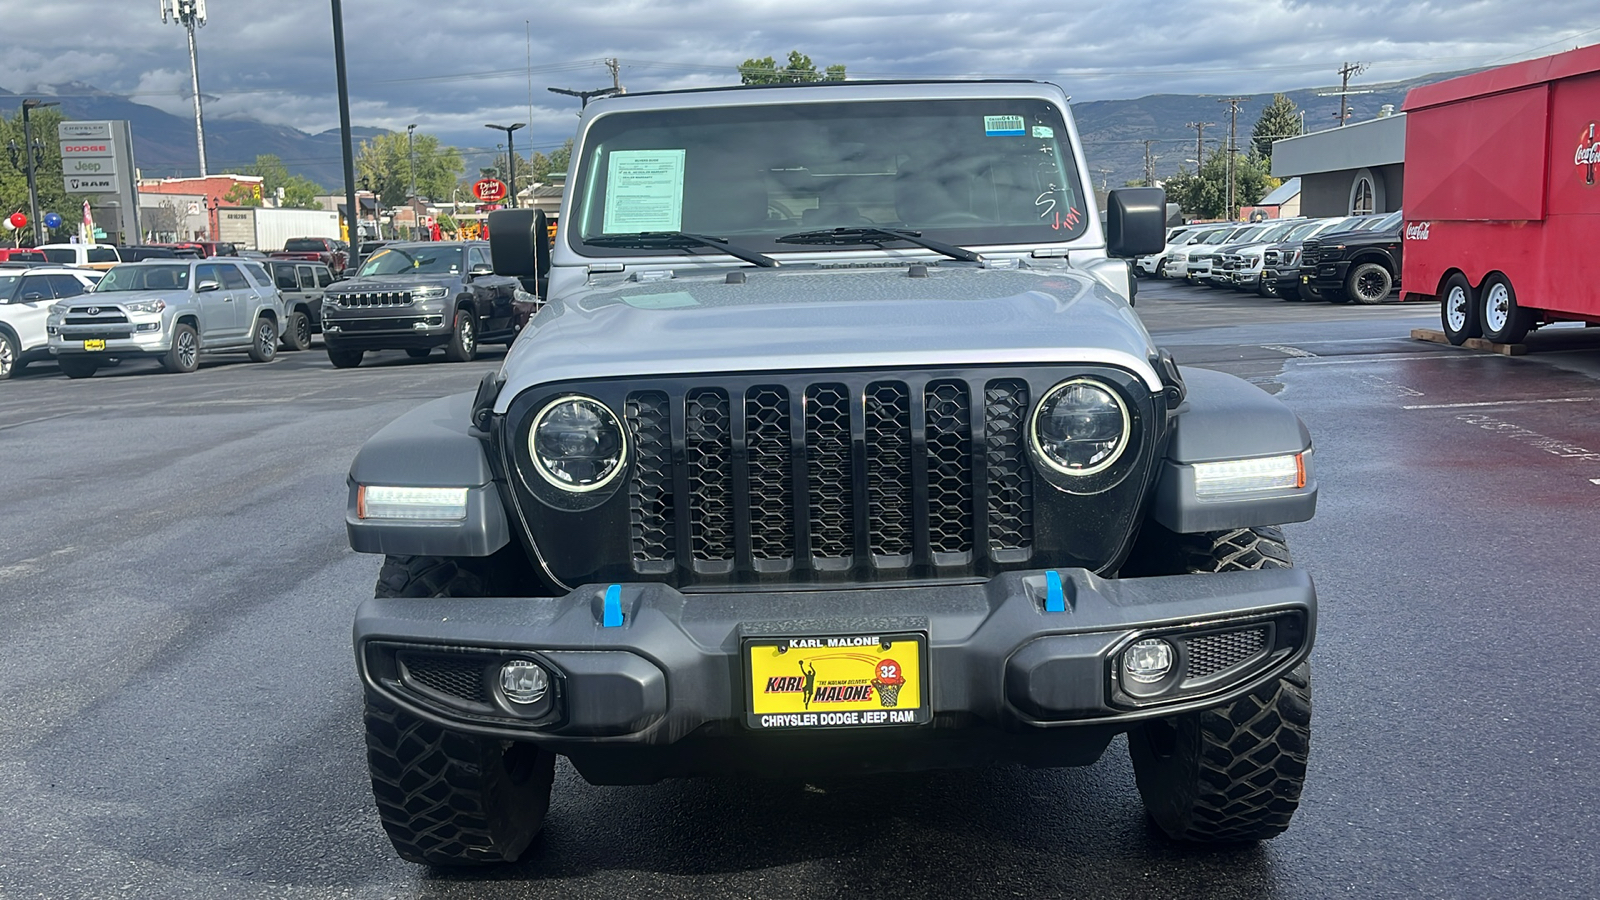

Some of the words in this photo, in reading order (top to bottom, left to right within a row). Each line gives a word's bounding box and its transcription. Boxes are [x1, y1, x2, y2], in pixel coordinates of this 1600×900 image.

[74, 161, 101, 172] Jeep
[789, 638, 824, 648] KARL
[828, 637, 880, 647] MALONE
[880, 665, 896, 678] 32
[764, 676, 805, 693] KARL
[812, 685, 873, 702] MALONE
[761, 714, 818, 727] CHRYSLER
[820, 712, 858, 725] DODGE
[860, 711, 887, 724] JEEP
[890, 710, 914, 723] RAM
